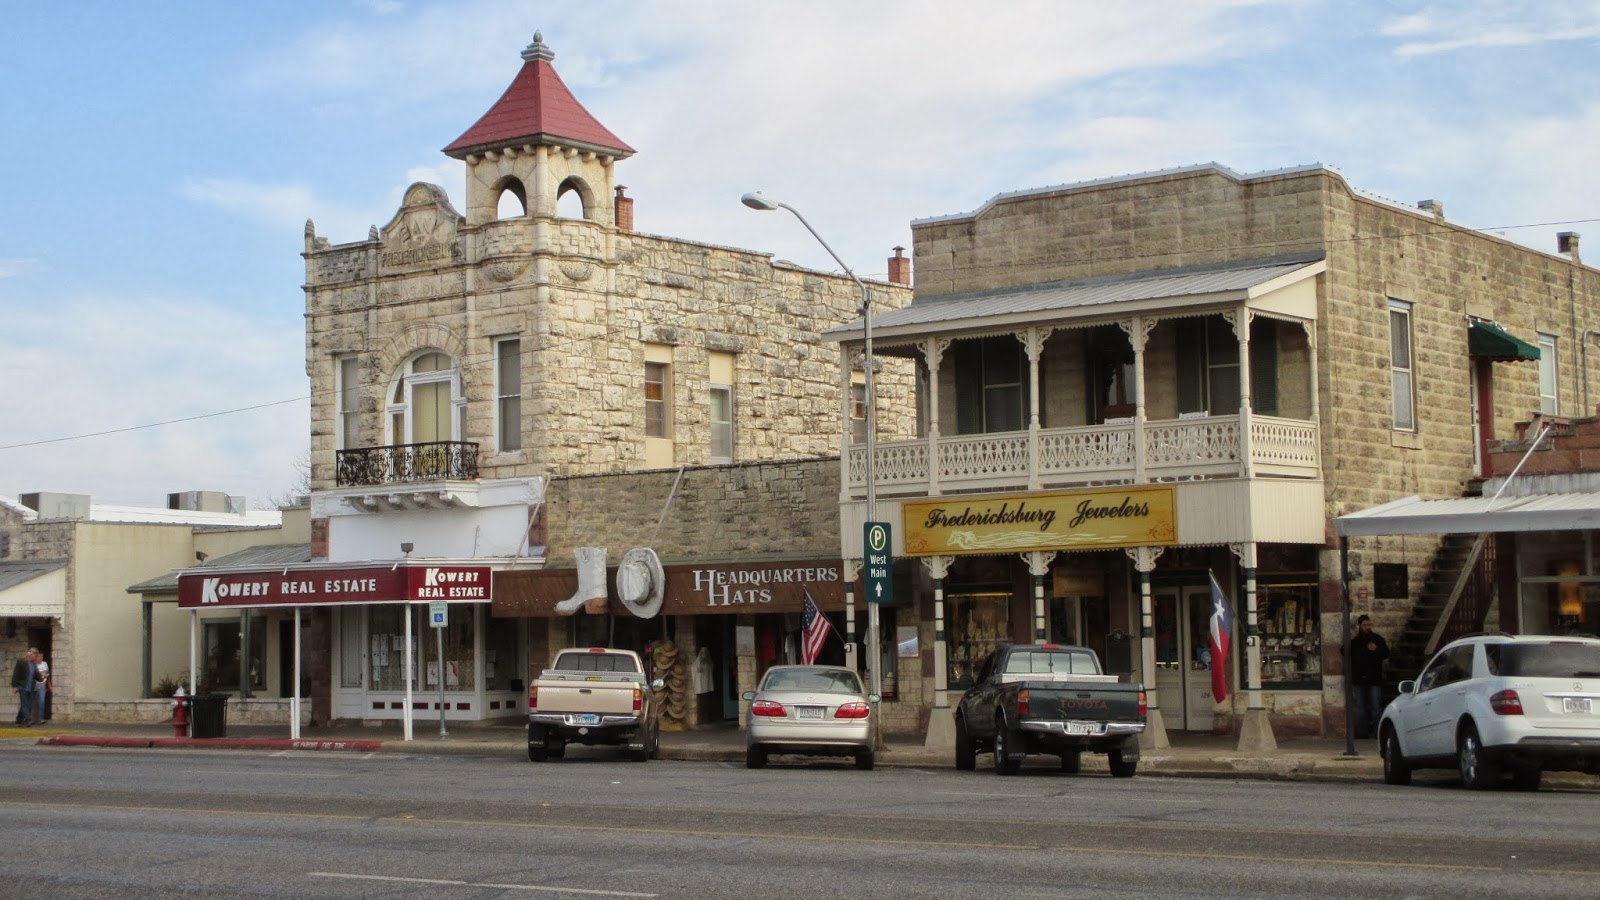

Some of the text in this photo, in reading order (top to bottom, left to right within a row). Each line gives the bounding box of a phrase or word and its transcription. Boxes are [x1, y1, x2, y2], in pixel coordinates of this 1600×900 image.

[924, 496, 1149, 532] Fredericksburg Jewelers
[874, 529, 882, 546] P
[870, 554, 887, 565] West
[425, 568, 479, 586] KOWERT
[693, 567, 839, 592] HEADQUARTERS
[870, 567, 887, 578] Main
[201, 577, 377, 603] KOWERT REAL ESTATE
[418, 586, 484, 598] REAL ESTATE
[707, 584, 772, 607] HATS
[1060, 699, 1107, 709] TOYOTA
